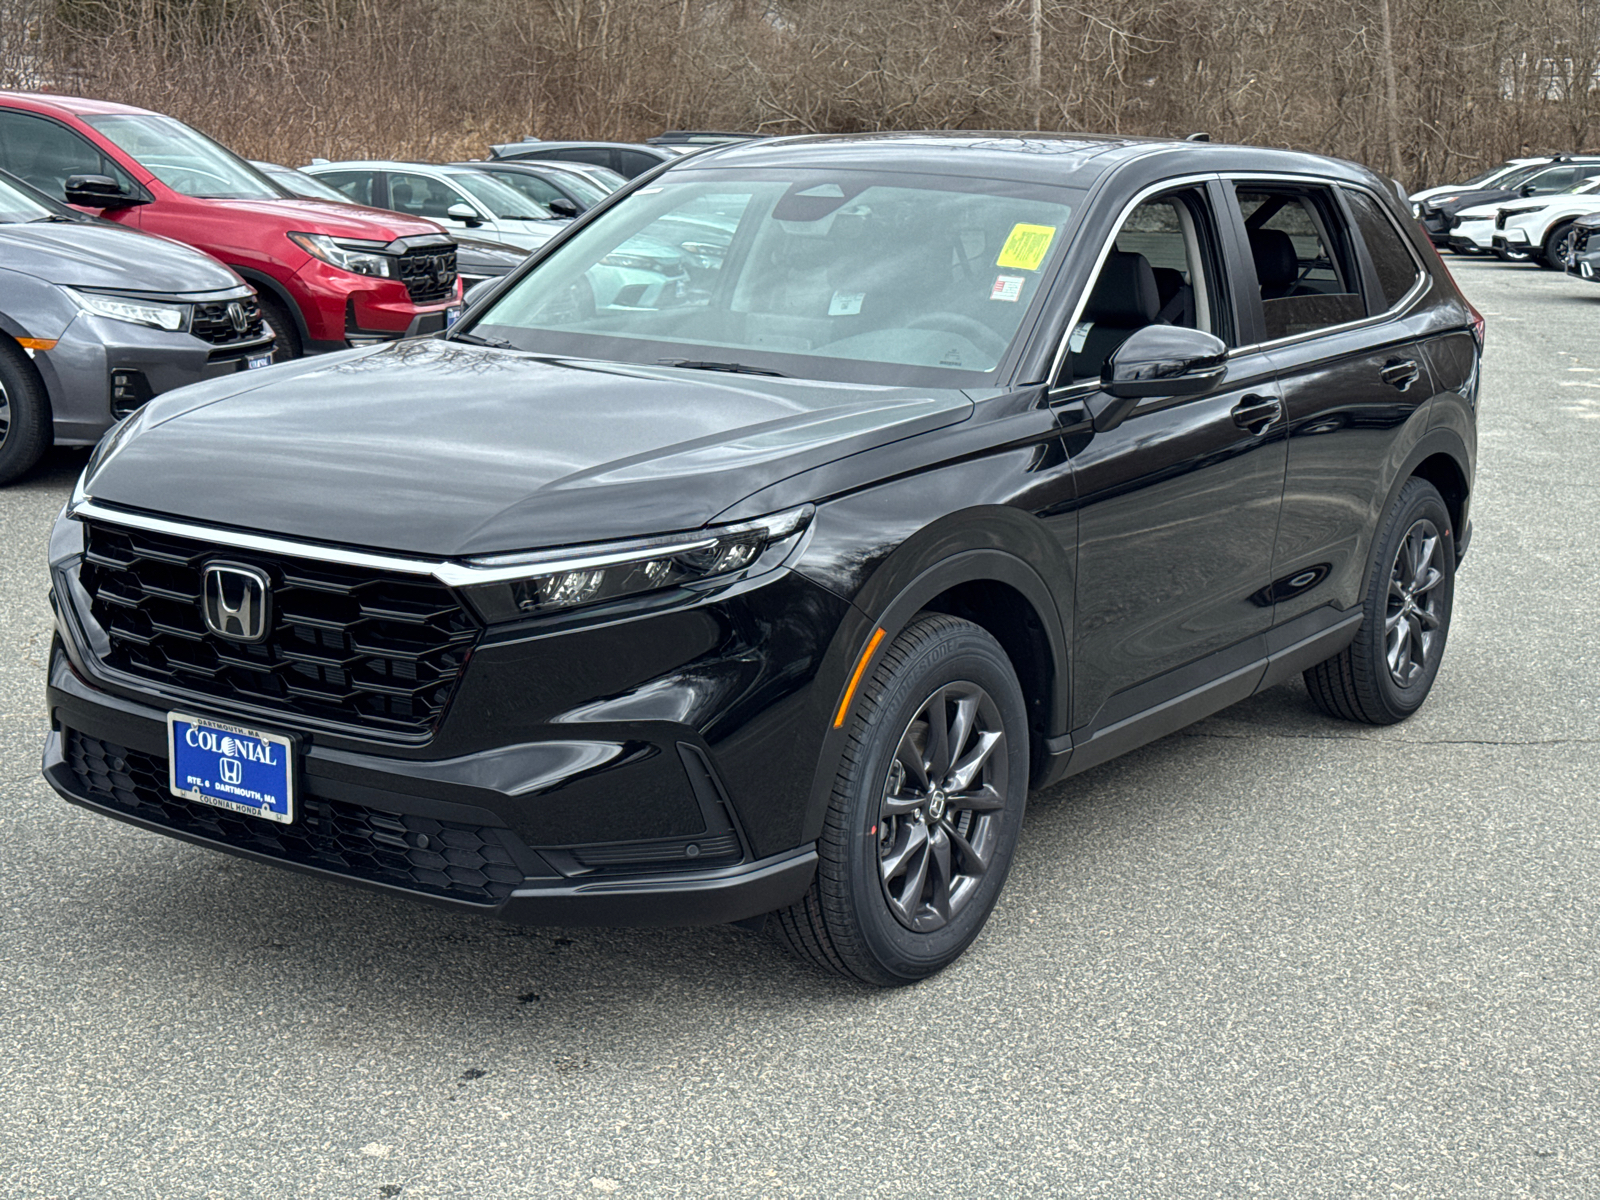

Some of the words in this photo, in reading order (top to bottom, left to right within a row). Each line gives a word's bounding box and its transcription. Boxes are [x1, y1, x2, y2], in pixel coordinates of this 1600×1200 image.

[248, 730, 260, 738] MA
[185, 728, 277, 766] COLONIAL
[187, 775, 204, 786] RTE.
[204, 780, 210, 788] 6
[215, 782, 263, 802] DARTMOUTH,
[264, 794, 276, 804] MA
[199, 795, 234, 810] COLONIAL
[236, 804, 262, 816] HONDA
